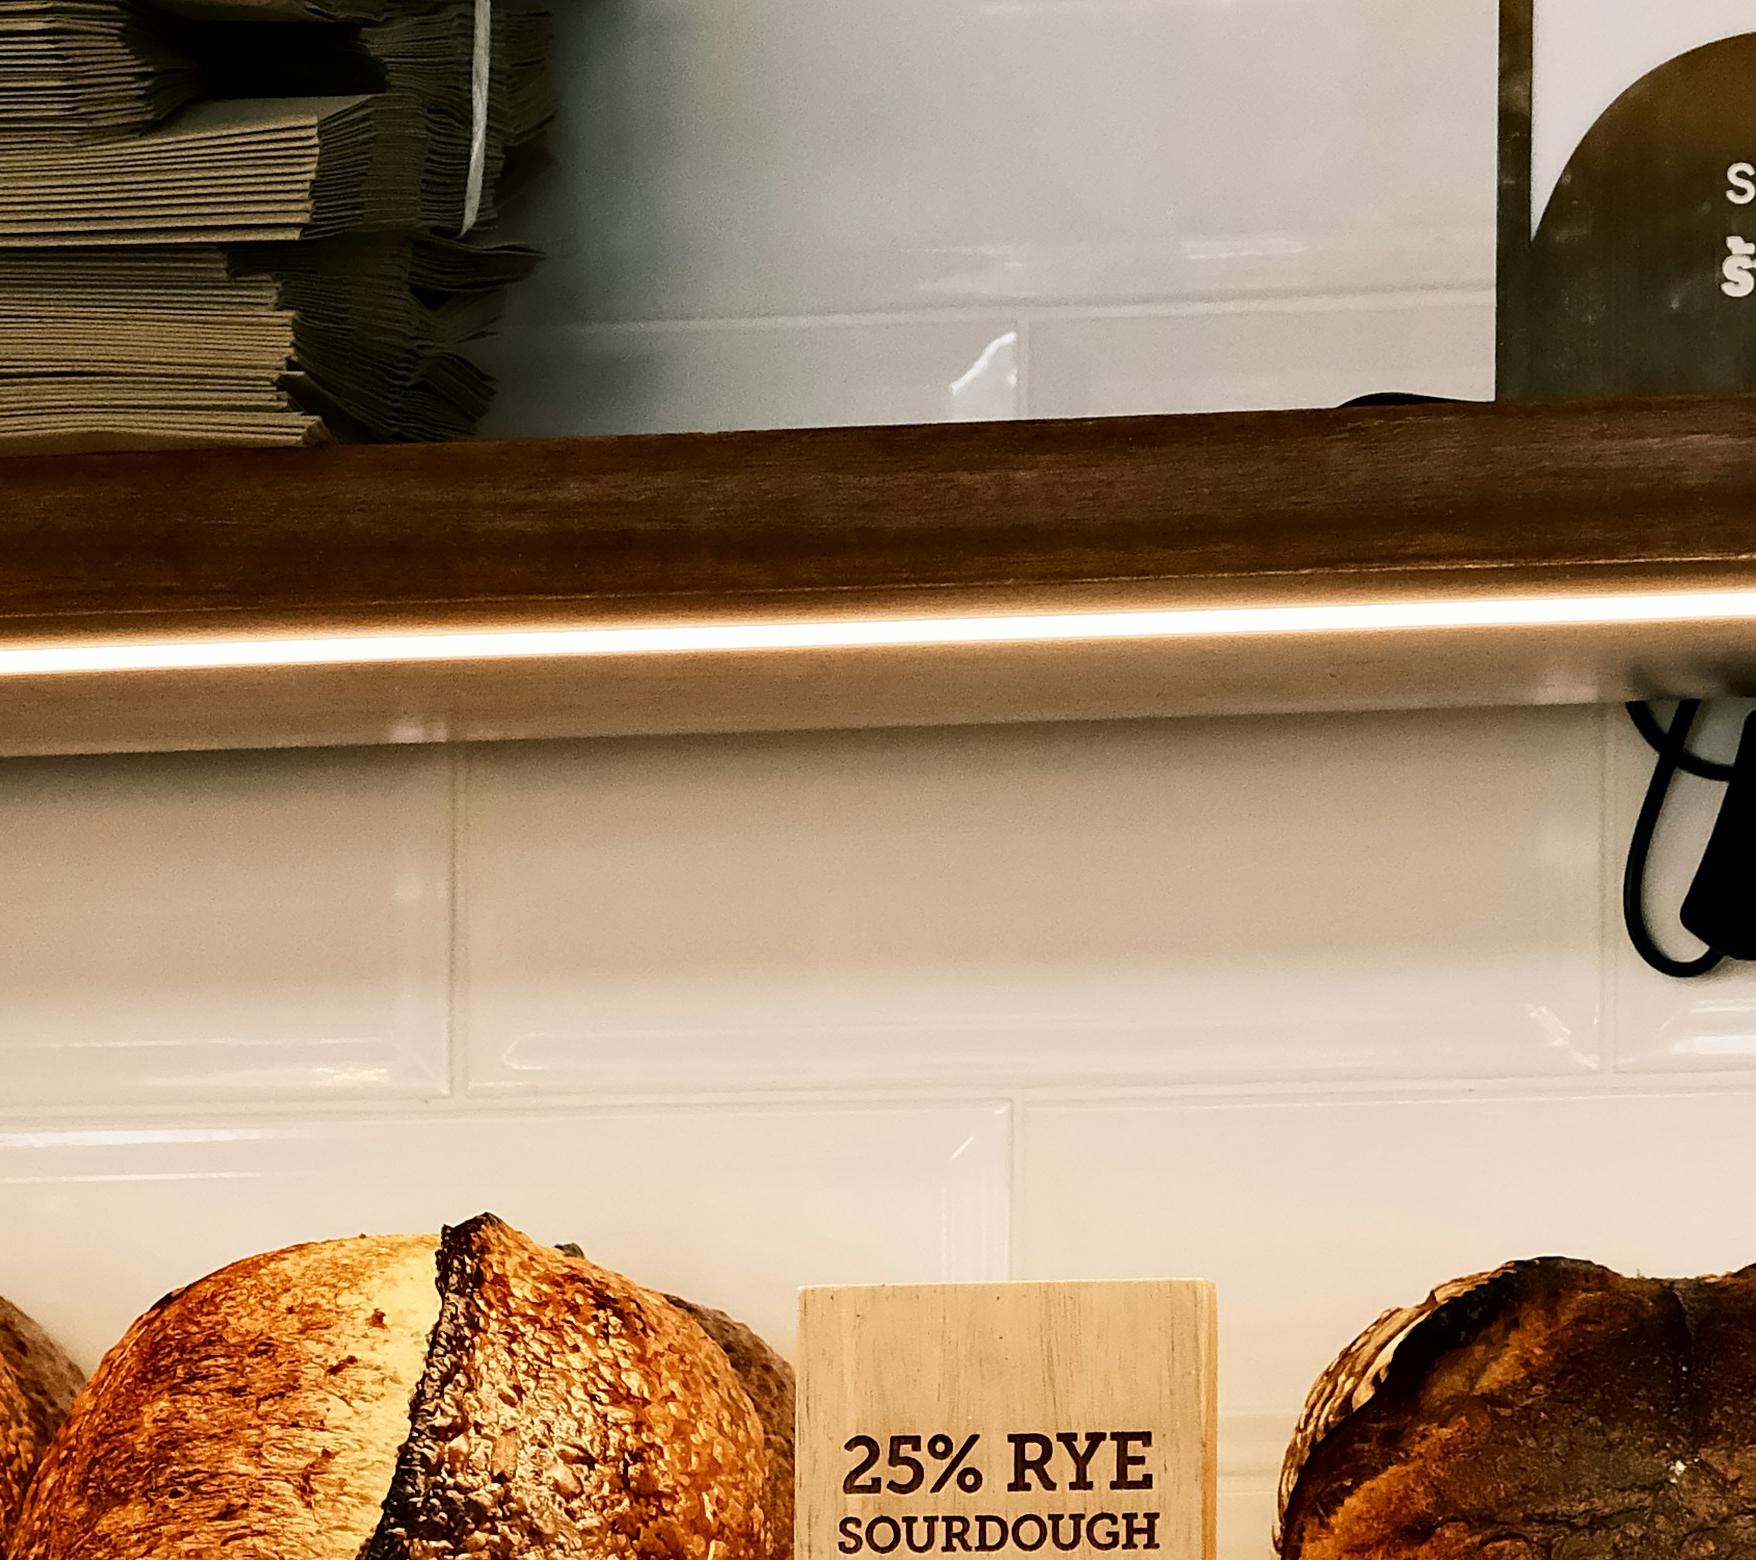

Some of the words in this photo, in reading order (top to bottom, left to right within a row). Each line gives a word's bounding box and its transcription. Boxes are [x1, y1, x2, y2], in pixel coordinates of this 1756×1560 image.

[842, 1433, 984, 1495] 25%
[1006, 1431, 1154, 1493] RYE
[837, 1511, 1160, 1555] SOURDOUGH
